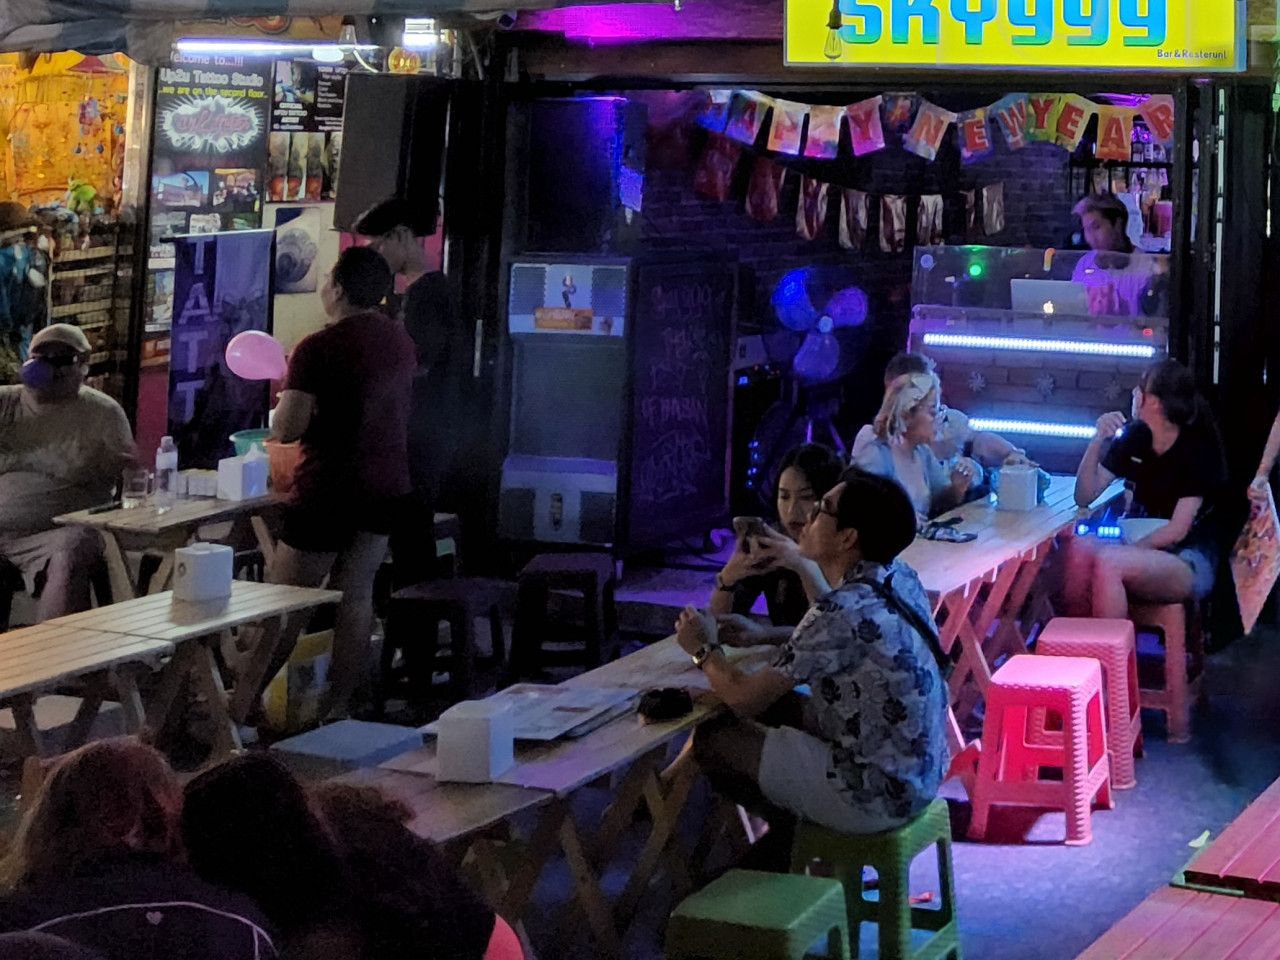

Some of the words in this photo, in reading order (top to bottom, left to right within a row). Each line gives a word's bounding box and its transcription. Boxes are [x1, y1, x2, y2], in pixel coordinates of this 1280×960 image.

[171, 52, 210, 64] elcome
[911, 101, 1028, 151] NEW
[1030, 96, 1175, 150] YEAR
